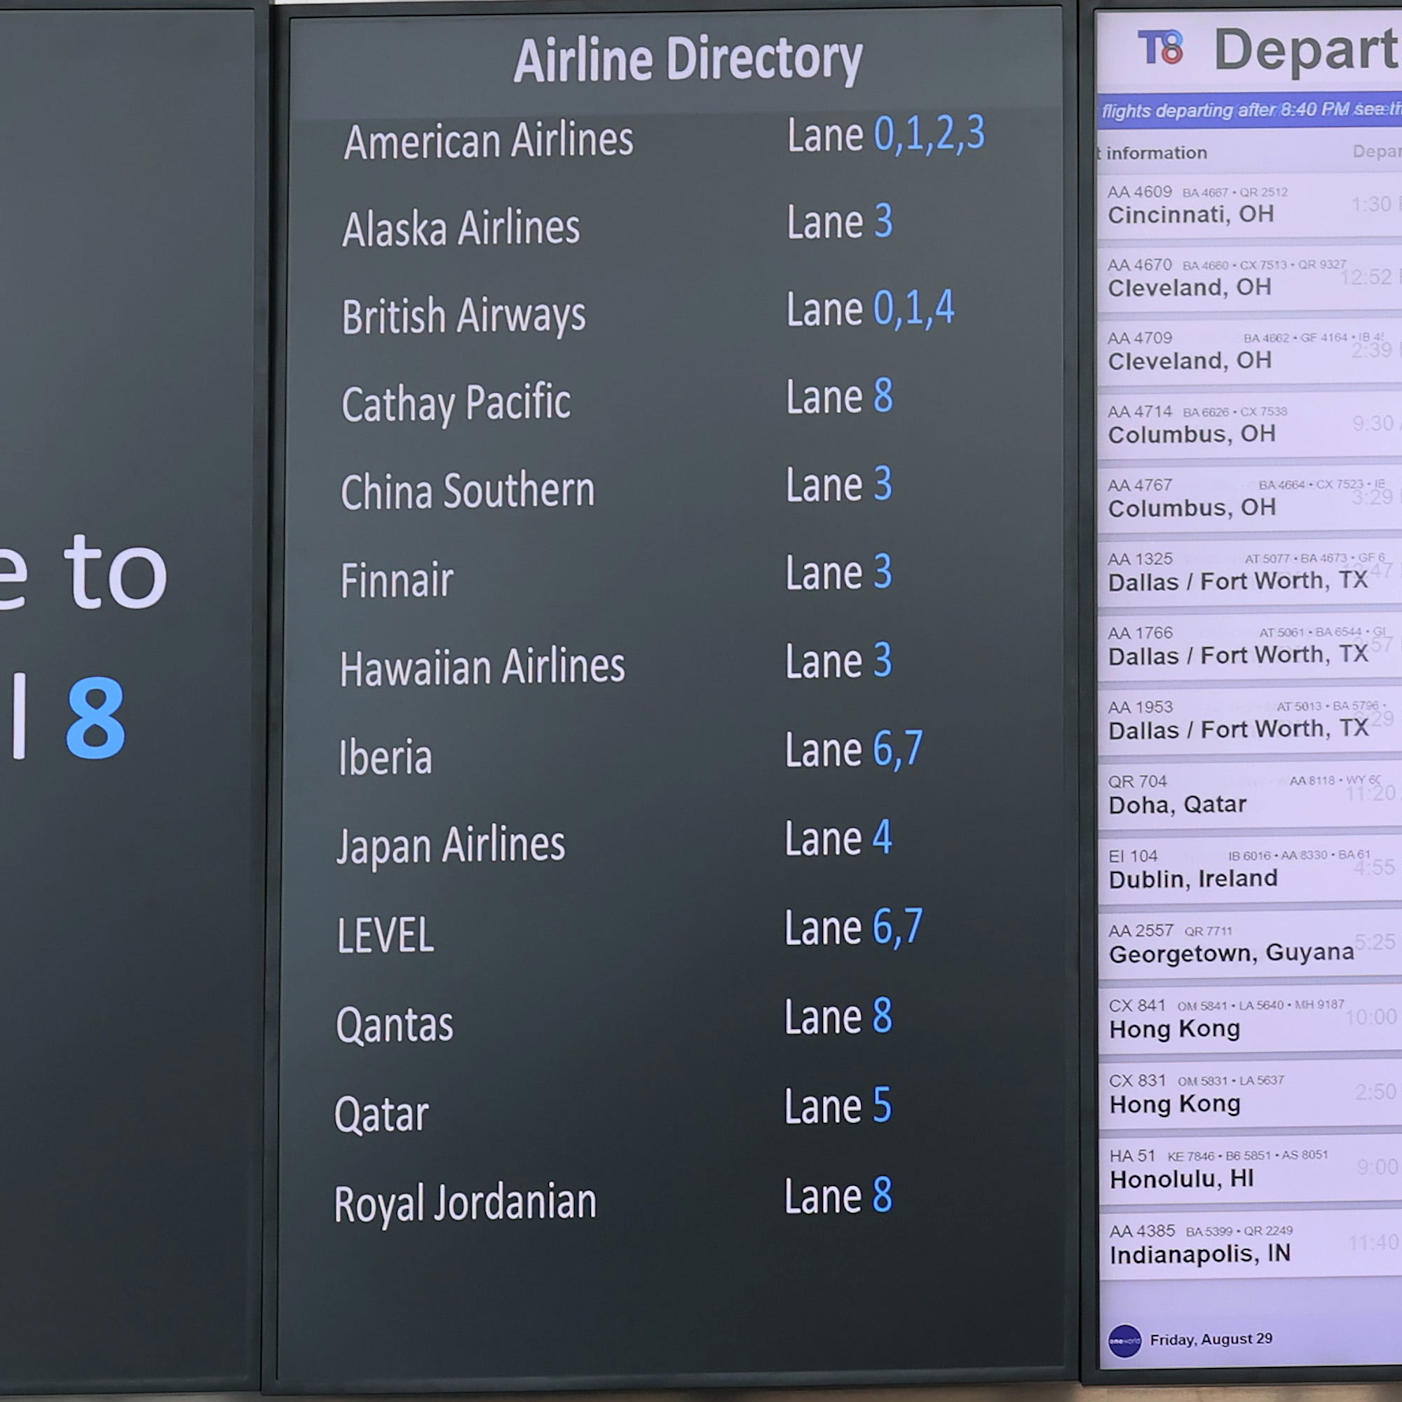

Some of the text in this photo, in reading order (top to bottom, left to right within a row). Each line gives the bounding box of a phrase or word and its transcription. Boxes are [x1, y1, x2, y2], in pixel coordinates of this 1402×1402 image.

[513, 33, 864, 89] Airline Directory
[1137, 28, 1184, 65] T8
[343, 118, 634, 160] American Airlines
[789, 113, 985, 157] Lane 0,1,2,3
[1107, 184, 1173, 199] AA 4609
[341, 206, 580, 248] Alaska Airlines
[788, 202, 893, 239] Lane 3
[1108, 204, 1274, 226] Cincinnati, OH
[343, 295, 586, 340] British Airways
[788, 288, 956, 332] Lane 0,1,4
[342, 380, 571, 430] Cathay Pacific
[787, 376, 893, 414] Lane 8
[341, 468, 594, 511] China Southern
[787, 464, 892, 502] Lane 3
[63, 533, 167, 610] to
[342, 560, 455, 599] Finnair
[787, 552, 892, 590] Lane 3
[341, 644, 625, 687] Hawaiian Airlines
[787, 640, 892, 679] Lane 3
[66, 675, 126, 760] 8
[340, 736, 432, 776] Iberia
[786, 729, 924, 773] Lane 6,7
[1109, 794, 1248, 815] Doha, Qatar
[336, 822, 566, 873] Japan Airlines
[786, 818, 893, 856] Lane 4
[338, 916, 435, 954] LEVEL
[786, 907, 924, 951] Lane 6,7
[1109, 942, 1354, 968] Georgetown, Guyana
[336, 1005, 454, 1048] Qantas
[786, 996, 893, 1035] Lane 8
[334, 1095, 430, 1137] Qatar
[785, 1085, 892, 1124] Lane 5
[335, 1180, 596, 1231] Royal Jordanian
[785, 1175, 893, 1215] Lane 8
[1150, 1332, 1273, 1349] Friday, August 29
